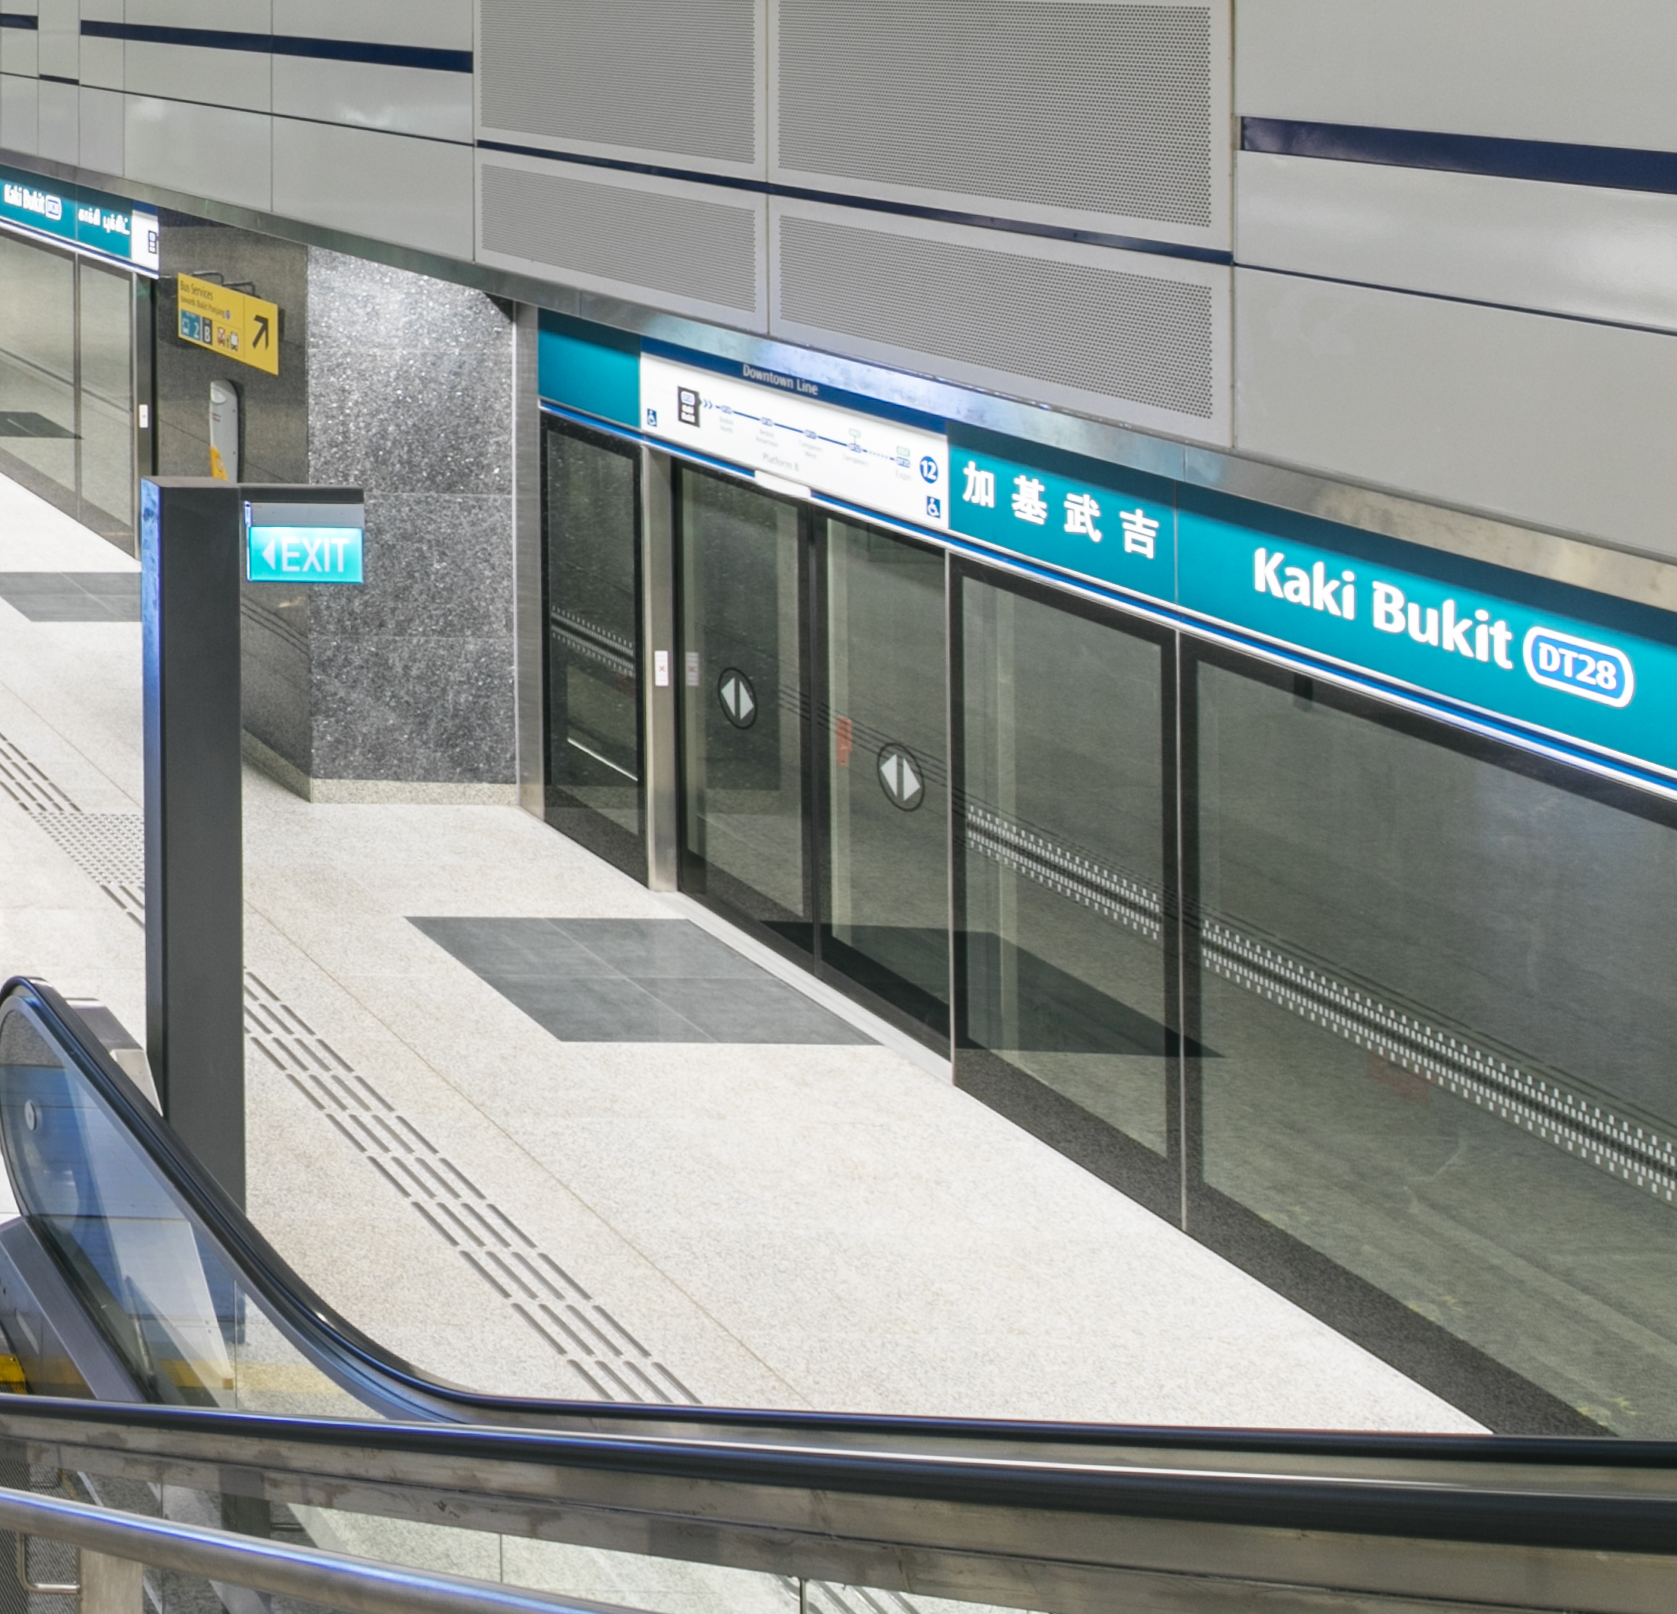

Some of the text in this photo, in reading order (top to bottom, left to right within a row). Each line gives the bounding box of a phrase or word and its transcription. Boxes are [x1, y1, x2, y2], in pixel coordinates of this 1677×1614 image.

[4, 184, 23, 205] Kaki
[180, 280, 213, 301] Bus Services
[193, 322, 200, 339] 2
[204, 326, 211, 343] B
[743, 363, 818, 396] Downtown Line
[762, 452, 793, 470] Platform
[920, 460, 937, 479] 12
[963, 462, 1159, 559] 加基武吉
[282, 537, 349, 572] EXIT
[1254, 548, 1617, 691] Kaki Bukit DT28
